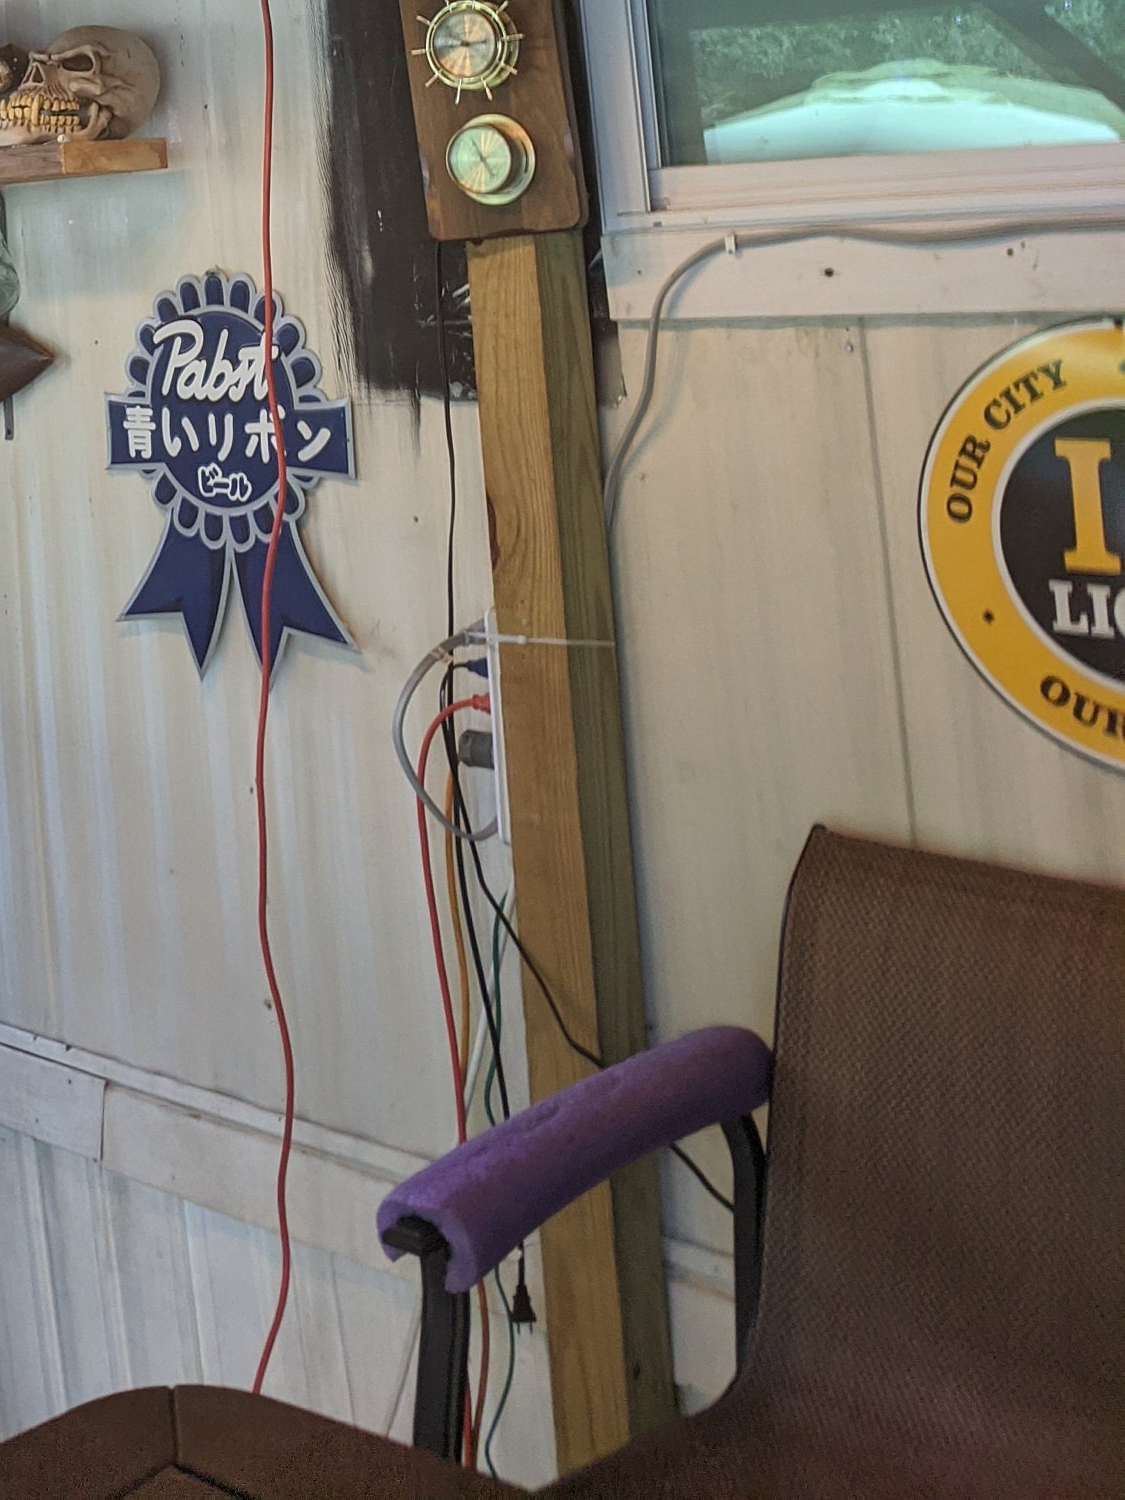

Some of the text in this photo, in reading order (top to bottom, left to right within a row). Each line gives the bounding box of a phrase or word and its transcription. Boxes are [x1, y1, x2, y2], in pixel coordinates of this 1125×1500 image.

[153, 319, 279, 401] Pabst
[122, 404, 332, 464] 青いリボン
[946, 358, 1068, 524] OUR CITY
[197, 462, 253, 502] ビール
